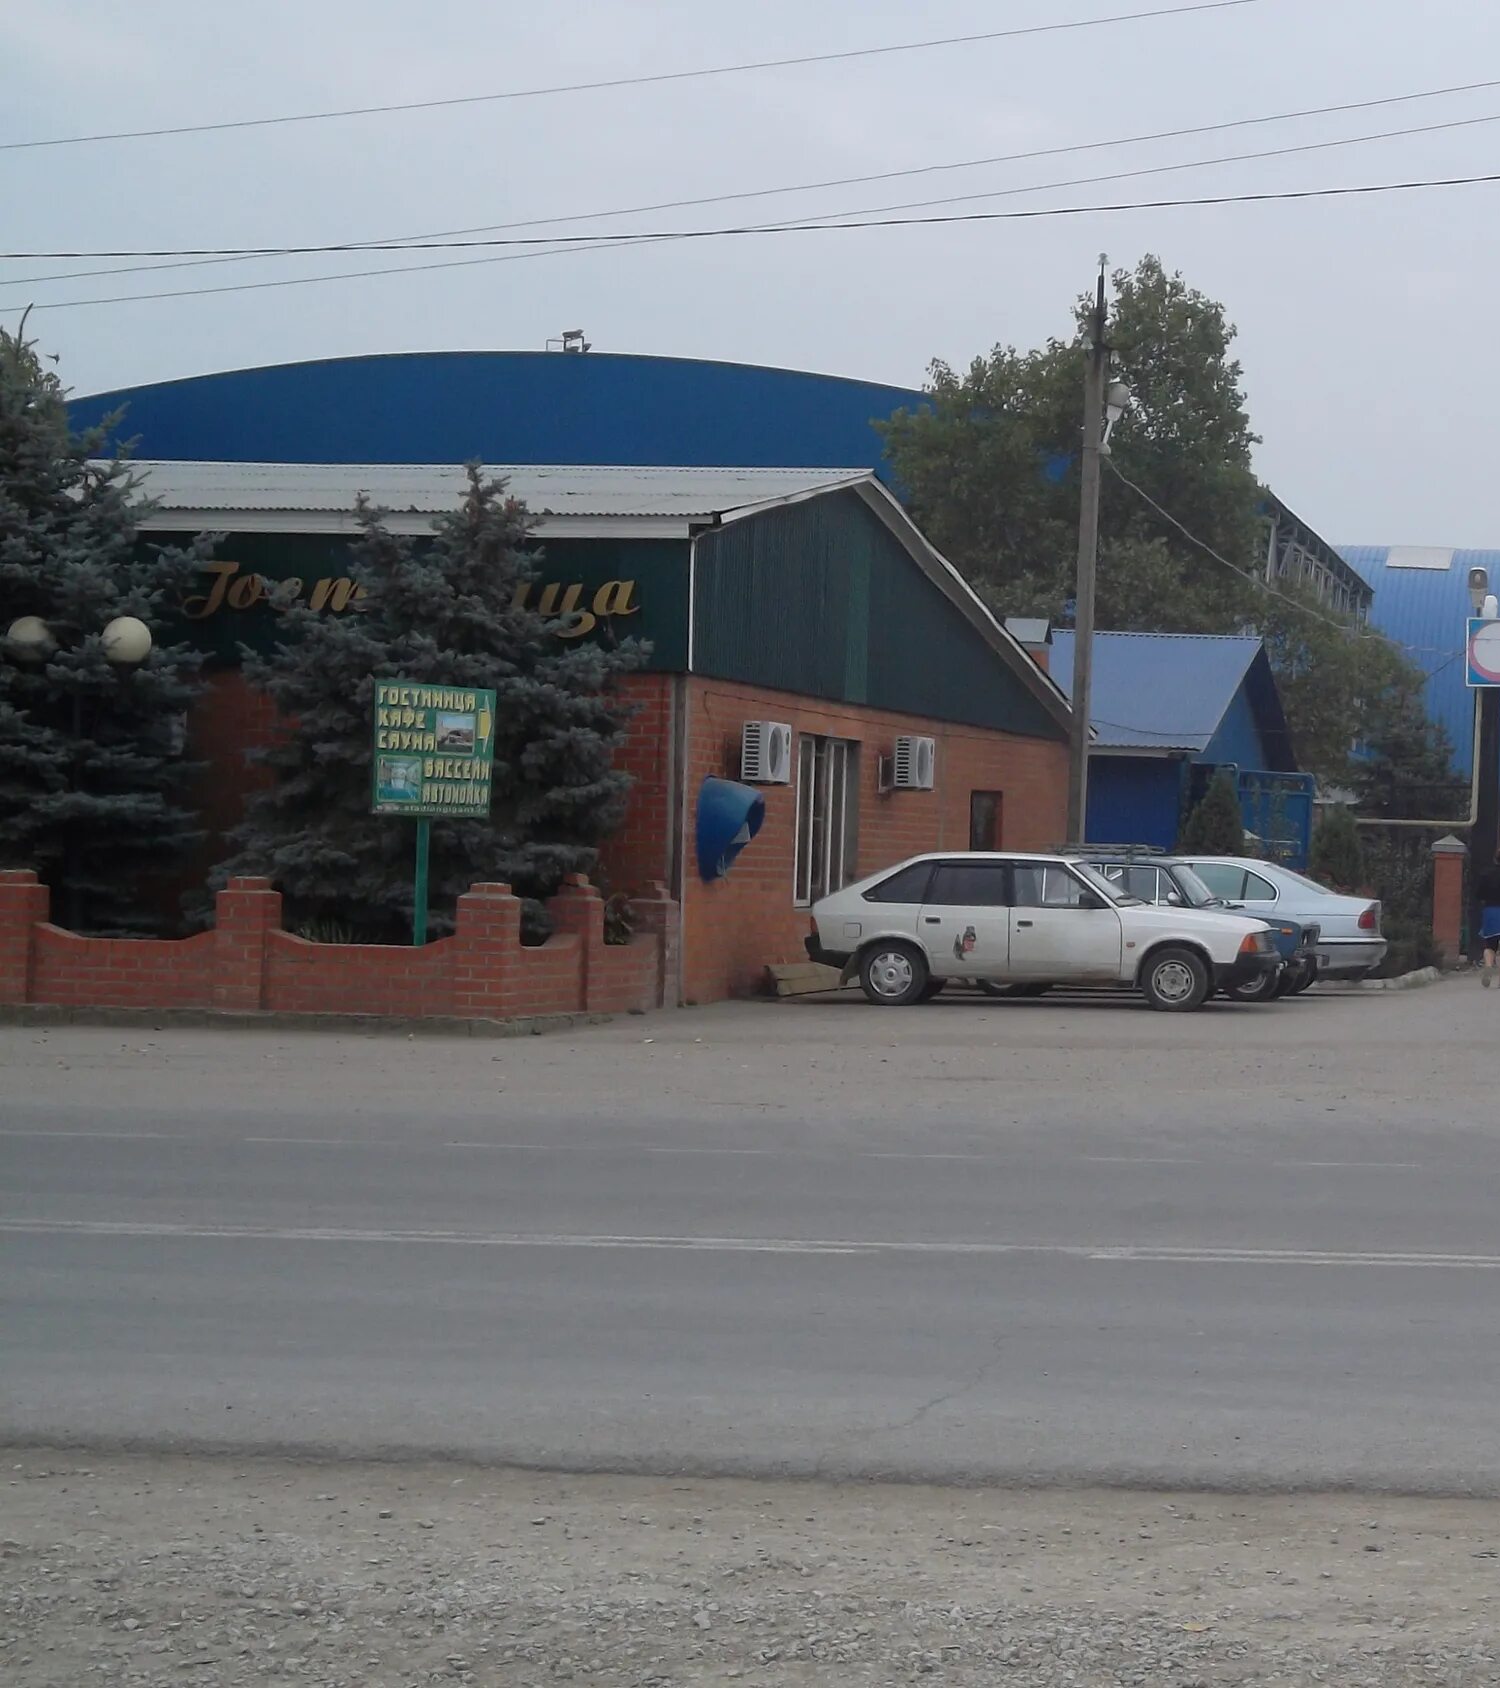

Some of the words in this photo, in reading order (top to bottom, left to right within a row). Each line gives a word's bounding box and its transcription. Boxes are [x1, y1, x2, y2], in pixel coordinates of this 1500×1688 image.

[377, 686, 476, 712] ГОСТИНИЦА
[377, 706, 426, 729] КАФЕ
[377, 730, 435, 750] САУНА
[424, 756, 490, 780] БАССЕЙН
[422, 781, 489, 804] АВТОМОЙКА
